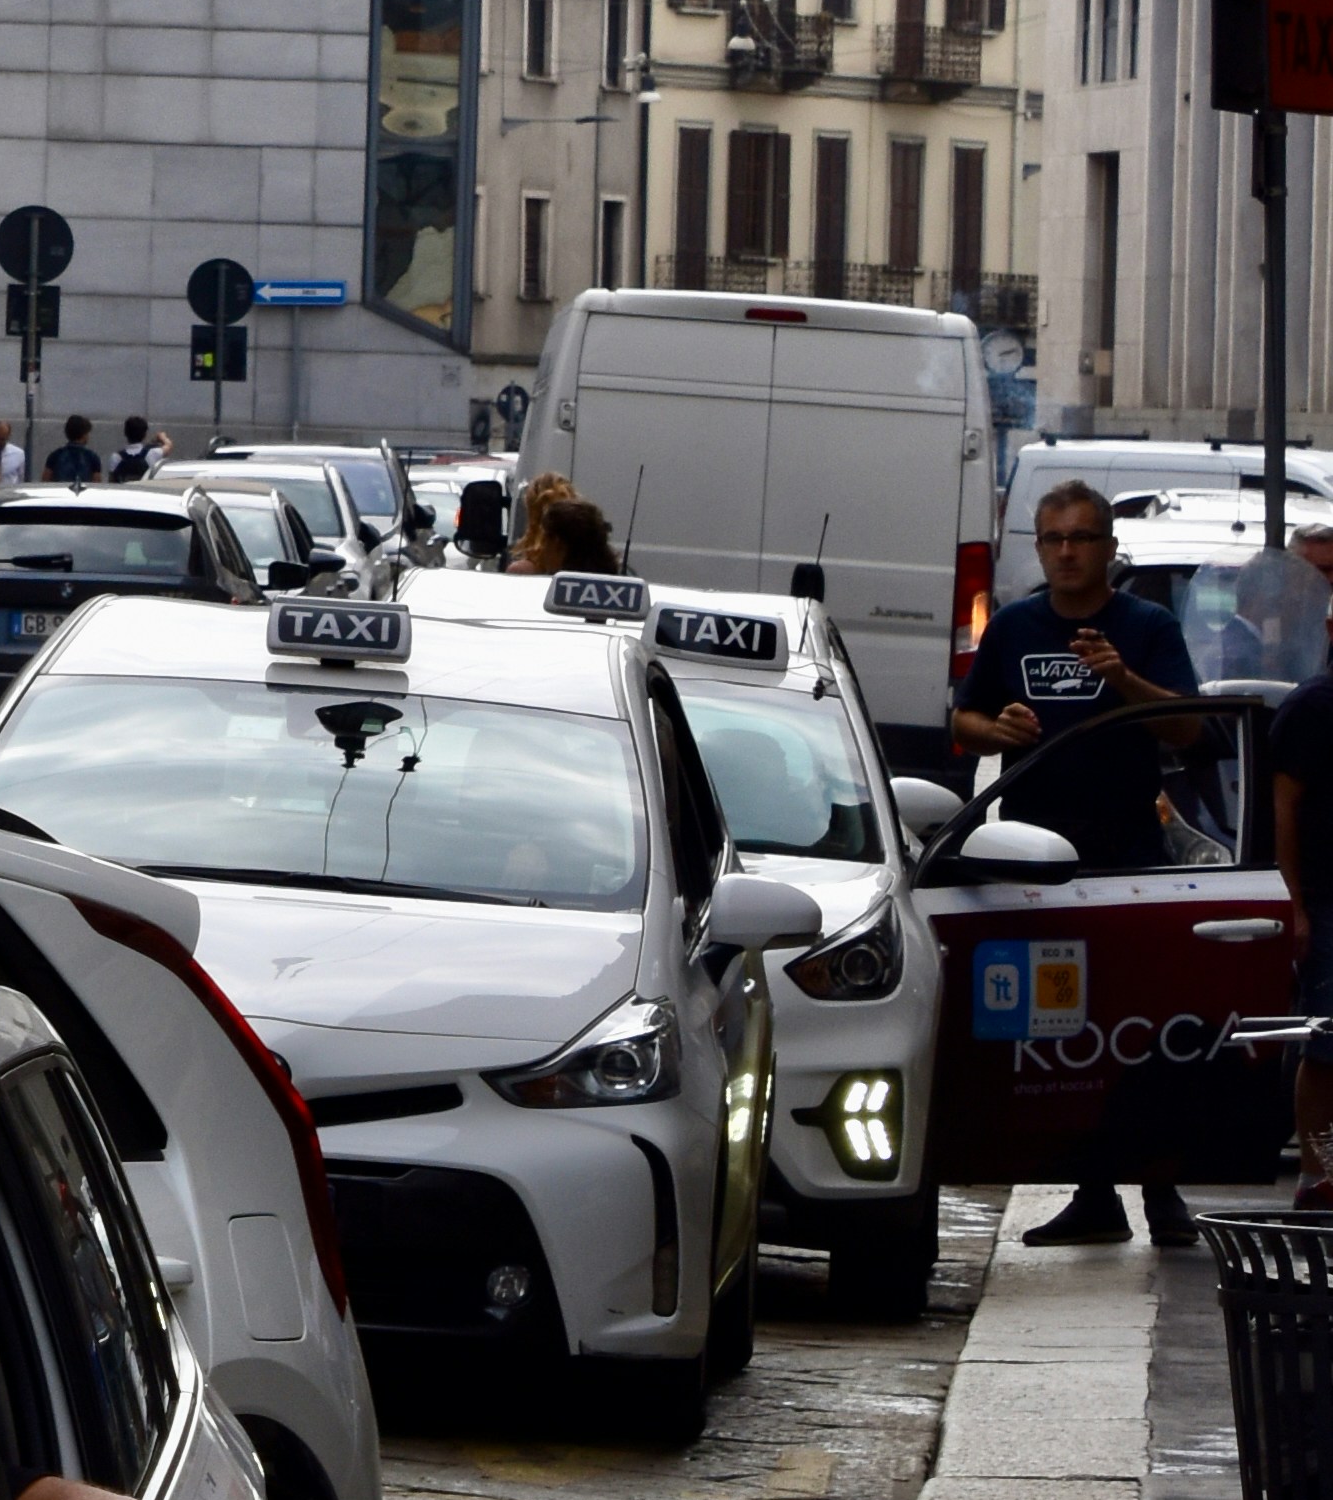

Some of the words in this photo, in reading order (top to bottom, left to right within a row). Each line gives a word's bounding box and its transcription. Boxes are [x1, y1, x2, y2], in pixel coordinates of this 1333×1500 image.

[560, 581, 637, 609] TAXI
[24, 614, 46, 634] GB
[286, 610, 390, 643] TAXI
[673, 612, 761, 653] TAXI
[1041, 661, 1092, 677] VANS
[1014, 1011, 1257, 1072] KOCCA
[1014, 1083, 1043, 1096] shop
[1045, 1082, 1057, 1093] at
[1060, 1079, 1104, 1092] kocca.it
